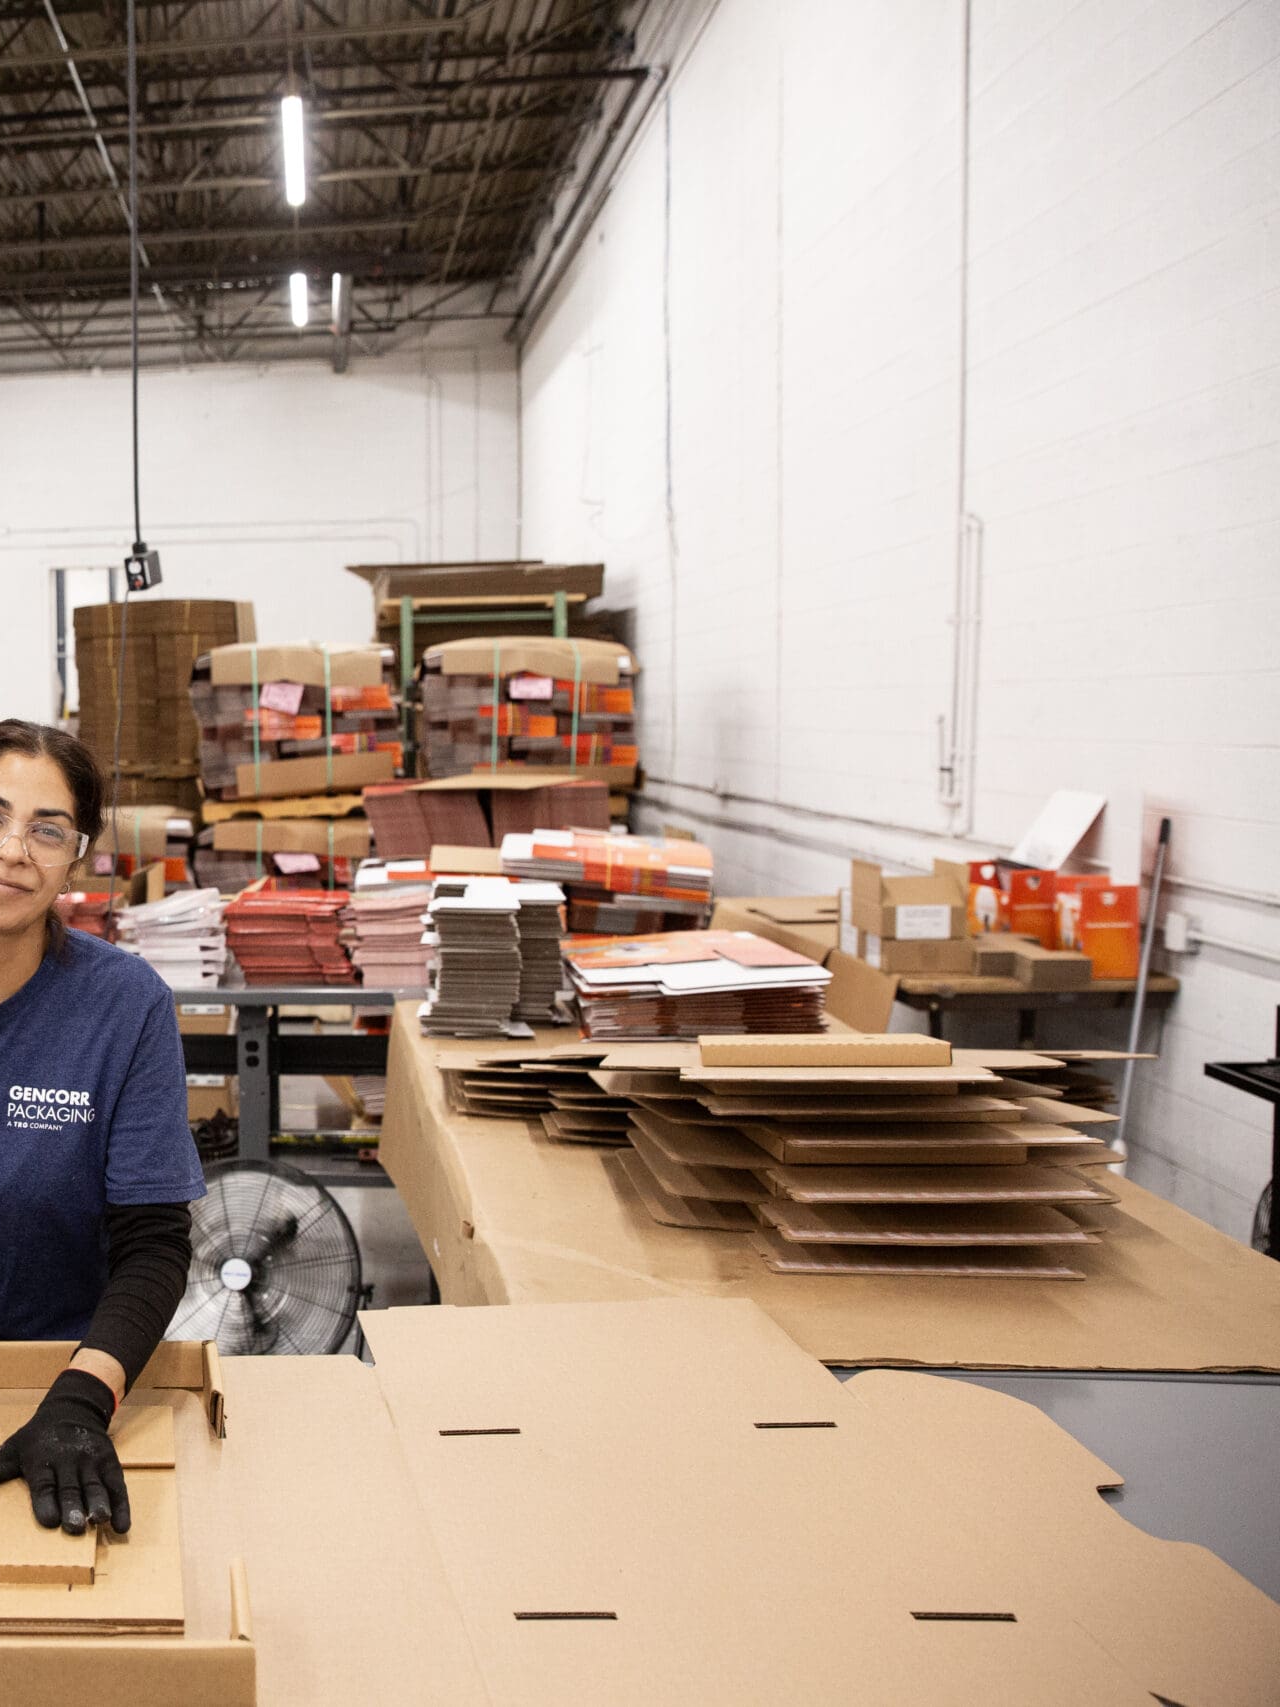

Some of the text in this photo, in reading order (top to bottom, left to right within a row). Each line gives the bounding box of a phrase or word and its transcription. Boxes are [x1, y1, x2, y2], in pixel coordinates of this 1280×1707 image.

[9, 1085, 90, 1106] GENCORR
[7, 1103, 95, 1123] PACKAGING
[29, 1122, 63, 1131] COMPANY
